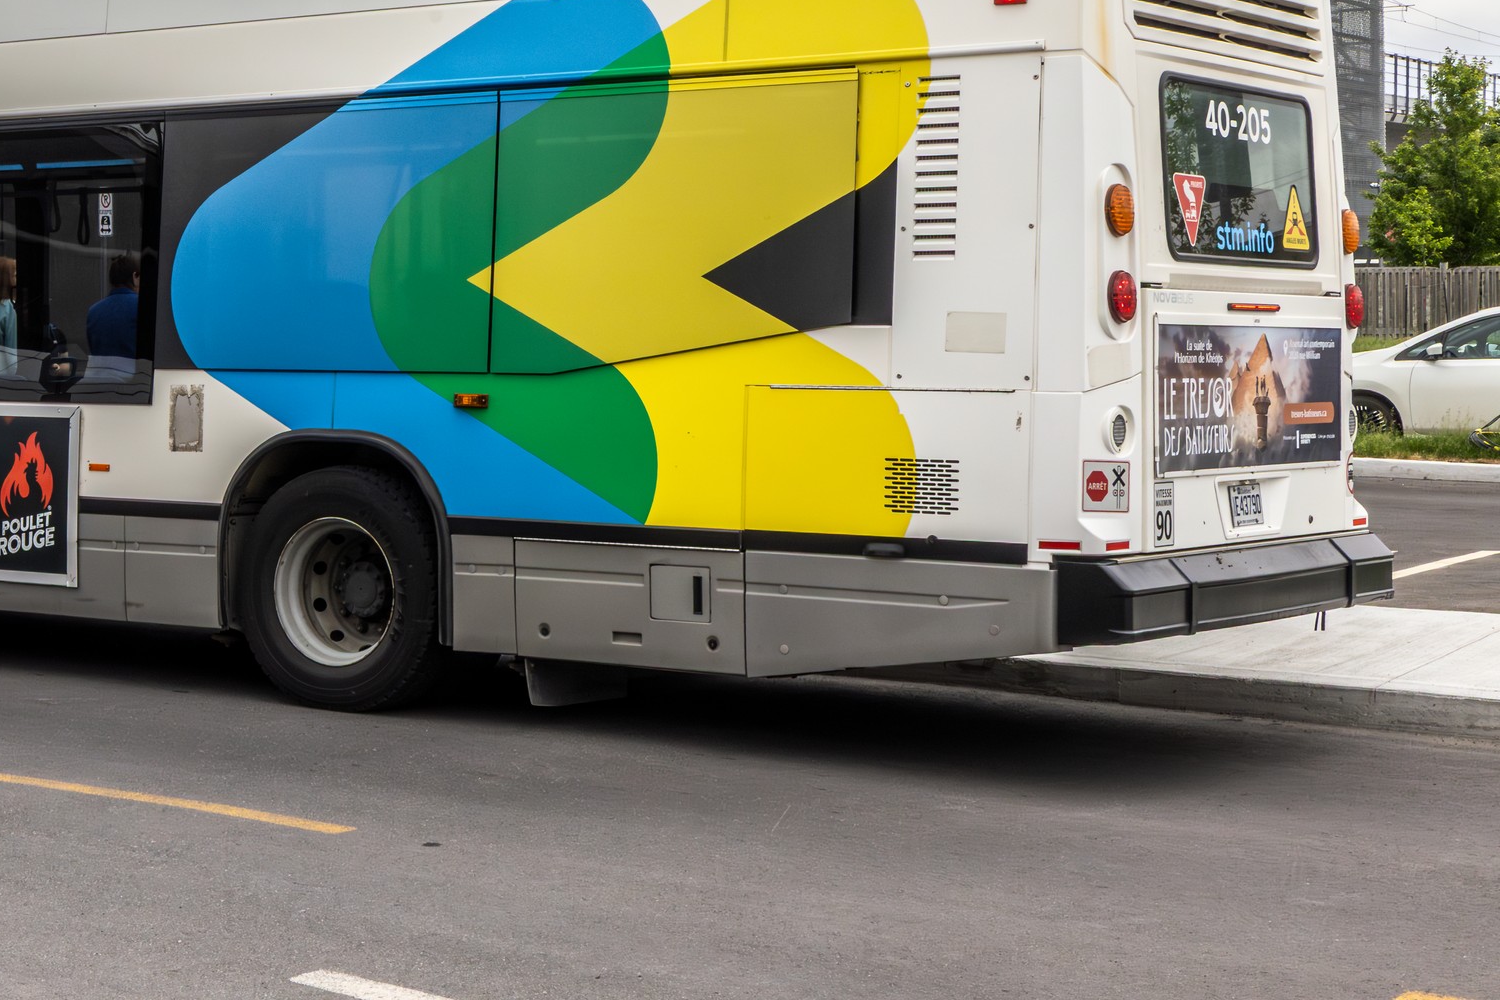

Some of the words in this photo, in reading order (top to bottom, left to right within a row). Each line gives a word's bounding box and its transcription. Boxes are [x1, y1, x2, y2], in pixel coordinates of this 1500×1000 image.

[1205, 99, 1271, 145] 40-205
[1216, 220, 1274, 254] stm.info
[1186, 340, 1193, 351] La
[1193, 340, 1205, 351] suite
[1205, 339, 1213, 351] de
[1164, 378, 1177, 420] LE
[1164, 426, 1183, 456] DES
[1087, 481, 1108, 491] ARRÊT
[2, 511, 52, 536] POULET
[1156, 509, 1172, 542] 90
